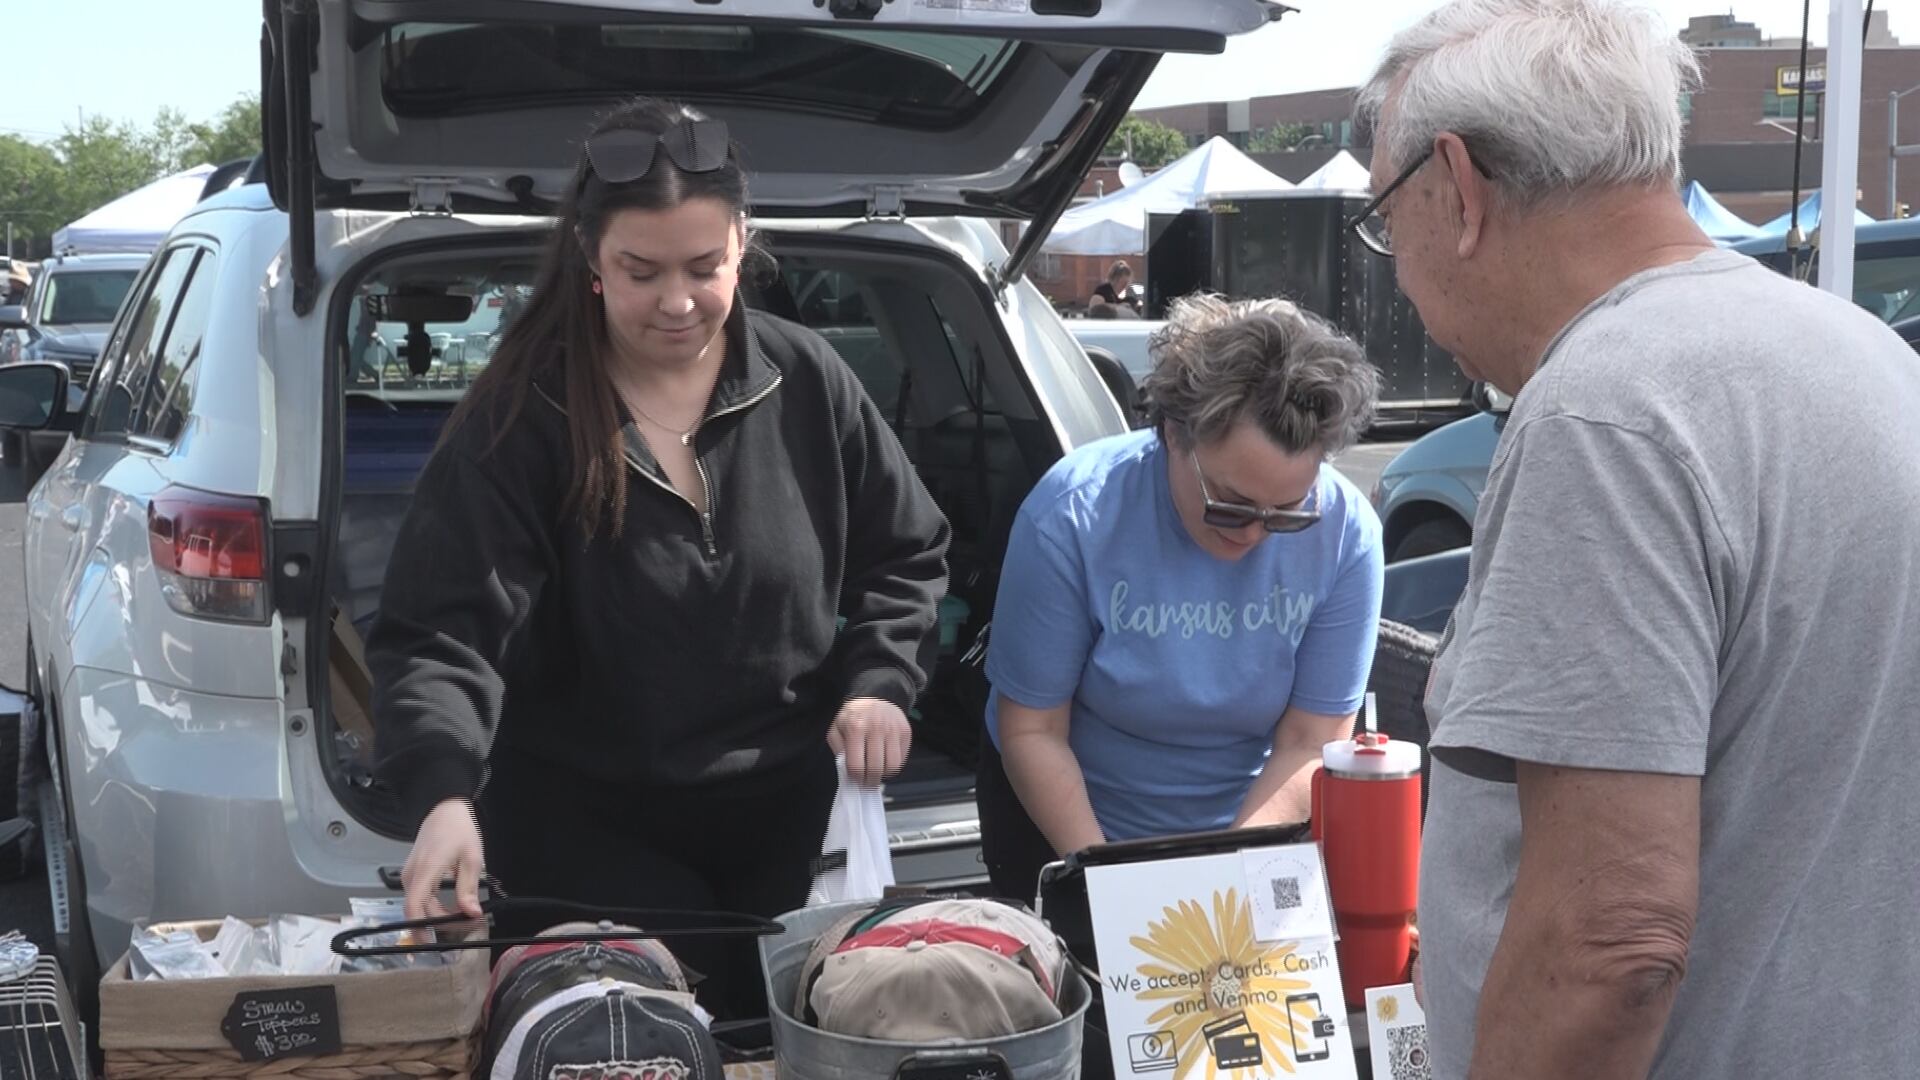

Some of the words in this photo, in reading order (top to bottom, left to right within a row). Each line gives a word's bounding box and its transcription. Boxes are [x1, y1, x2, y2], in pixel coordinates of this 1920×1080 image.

[1110, 580, 1236, 639] kansas
[1243, 583, 1314, 646] city
[1109, 973, 1142, 993] We
[1147, 967, 1213, 989] accept:
[1218, 957, 1279, 981] Cards,
[1283, 950, 1329, 972] Cash
[1173, 993, 1209, 1015] and
[1213, 988, 1278, 1008] Venmo
